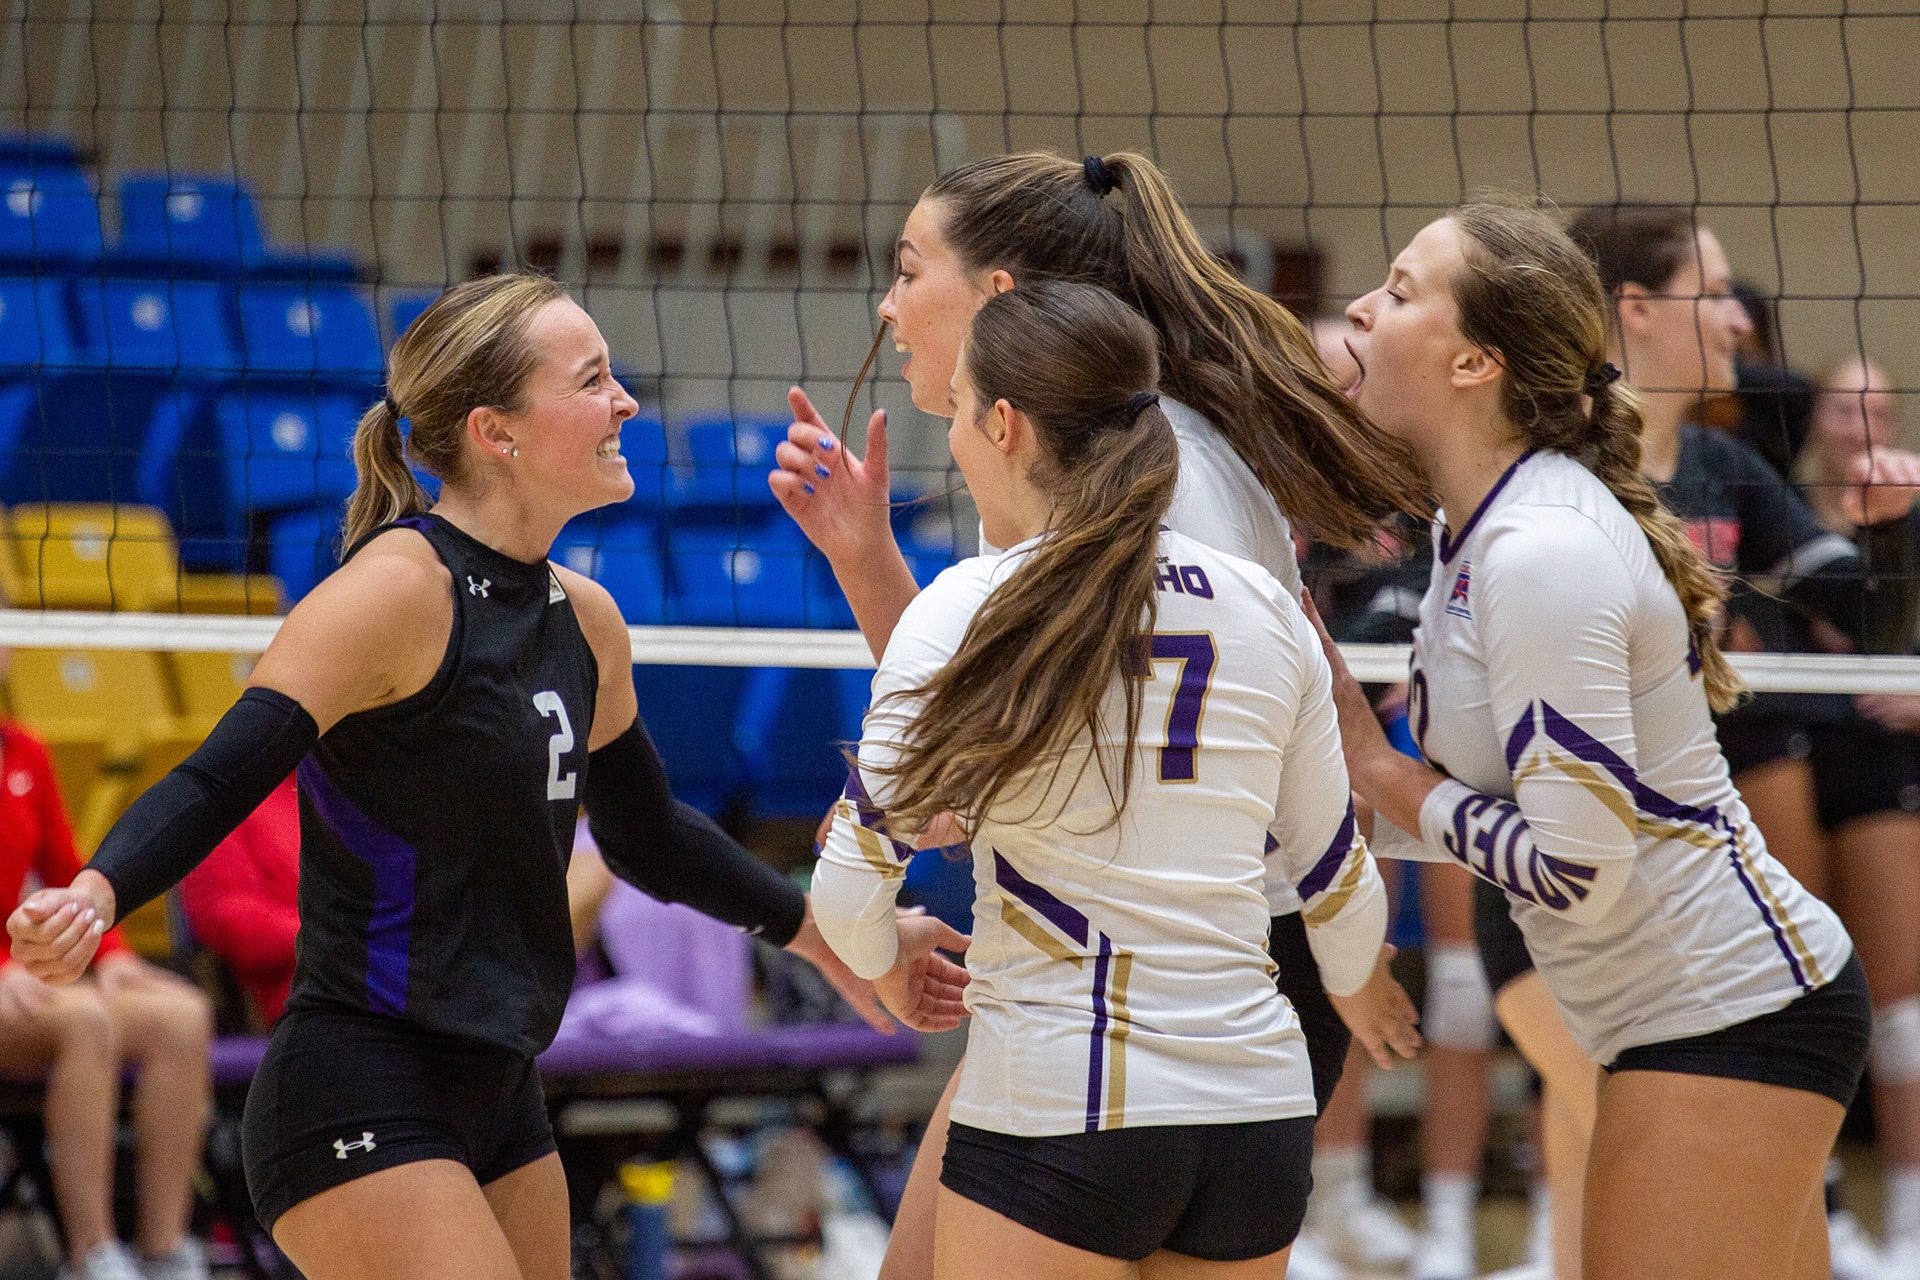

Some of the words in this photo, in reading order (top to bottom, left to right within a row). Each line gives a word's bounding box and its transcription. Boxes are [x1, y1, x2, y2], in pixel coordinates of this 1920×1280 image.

[532, 690, 577, 801] 2
[1126, 630, 1220, 784] 7
[1444, 793, 1599, 911] YOTES
